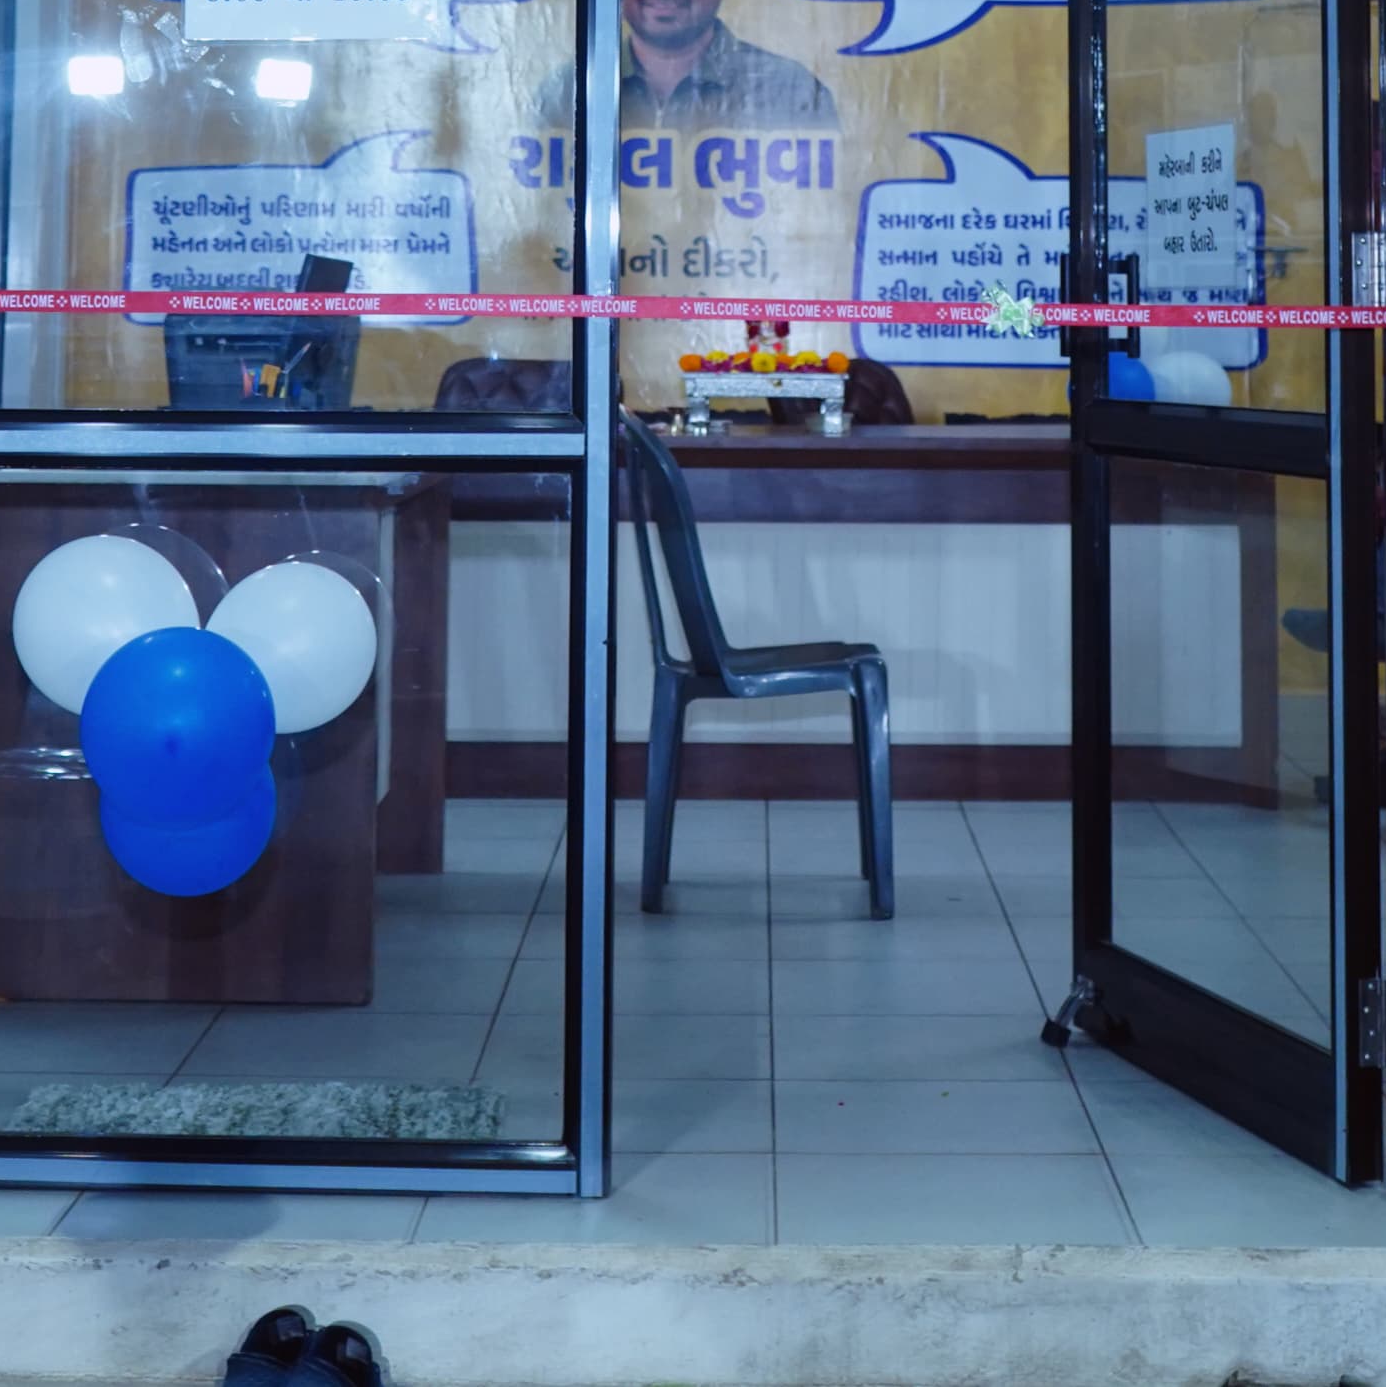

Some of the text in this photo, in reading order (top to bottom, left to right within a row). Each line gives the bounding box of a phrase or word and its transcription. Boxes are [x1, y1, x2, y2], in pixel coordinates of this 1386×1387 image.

[694, 136, 835, 219] ભુવા
[878, 213, 955, 230] સમાજના
[961, 206, 997, 230] દરેક
[212, 230, 247, 253] અને
[70, 295, 125, 309] WELCOME
[183, 296, 238, 310] WELCOME
[324, 298, 380, 311] WELCOME
[438, 298, 493, 312] WELCOME
[580, 299, 637, 313] WELCOME
[693, 301, 749, 316] WELCOME
[836, 304, 892, 319] WELCOME
[1093, 309, 1150, 322] WELCOME
[1207, 310, 1263, 324] WELCOME
